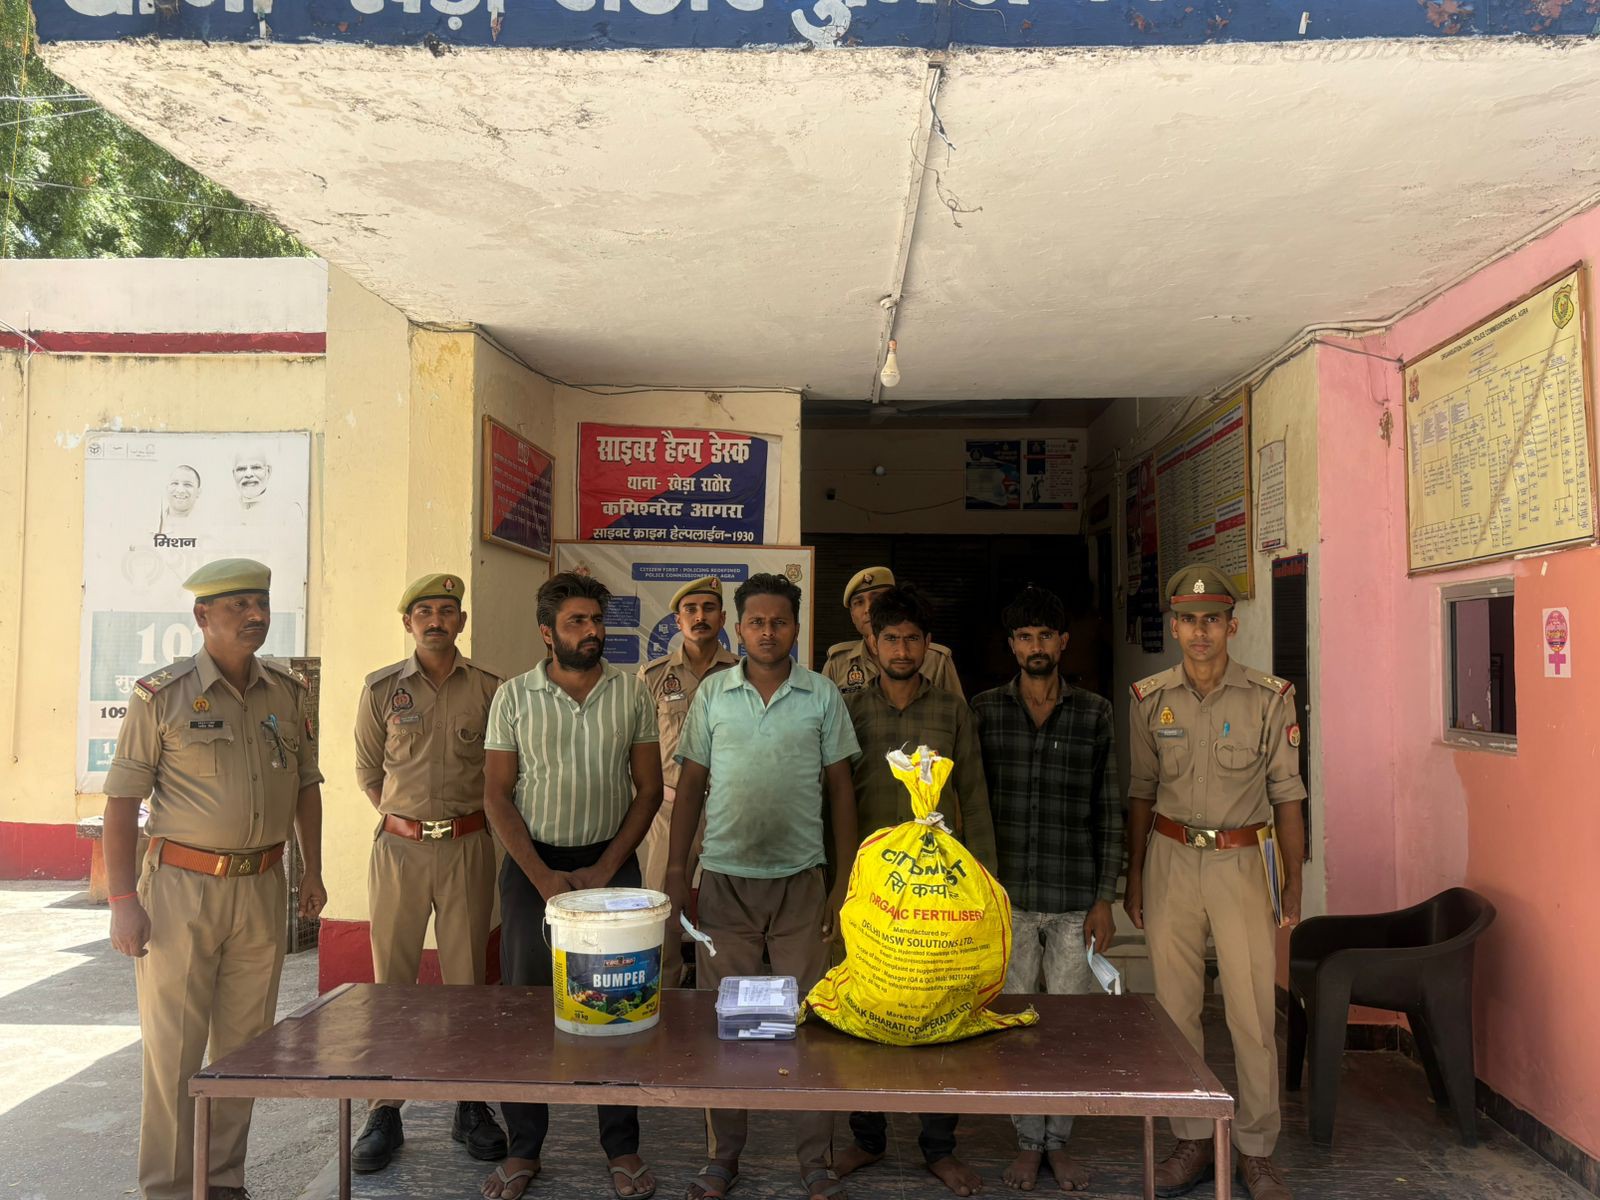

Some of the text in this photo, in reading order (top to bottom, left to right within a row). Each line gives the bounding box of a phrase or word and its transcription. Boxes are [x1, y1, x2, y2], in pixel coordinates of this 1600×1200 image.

[597, 430, 752, 467] साइबर हैल्प डेस्क
[667, 473, 696, 495] खेड़ा
[700, 473, 732, 493] राठौर
[690, 503, 744, 519] आगरा
[154, 533, 197, 548] मिशन
[633, 527, 667, 541] क्राइम
[862, 920, 881, 938] DELHI
[881, 932, 905, 947] MSW
[907, 937, 959, 949] SOLUTIONS
[893, 926, 940, 938] Manufactured
[592, 970, 646, 988] BUMPER
[869, 1011, 906, 1032] BHARATI
[886, 1010, 920, 1022] Marketed
